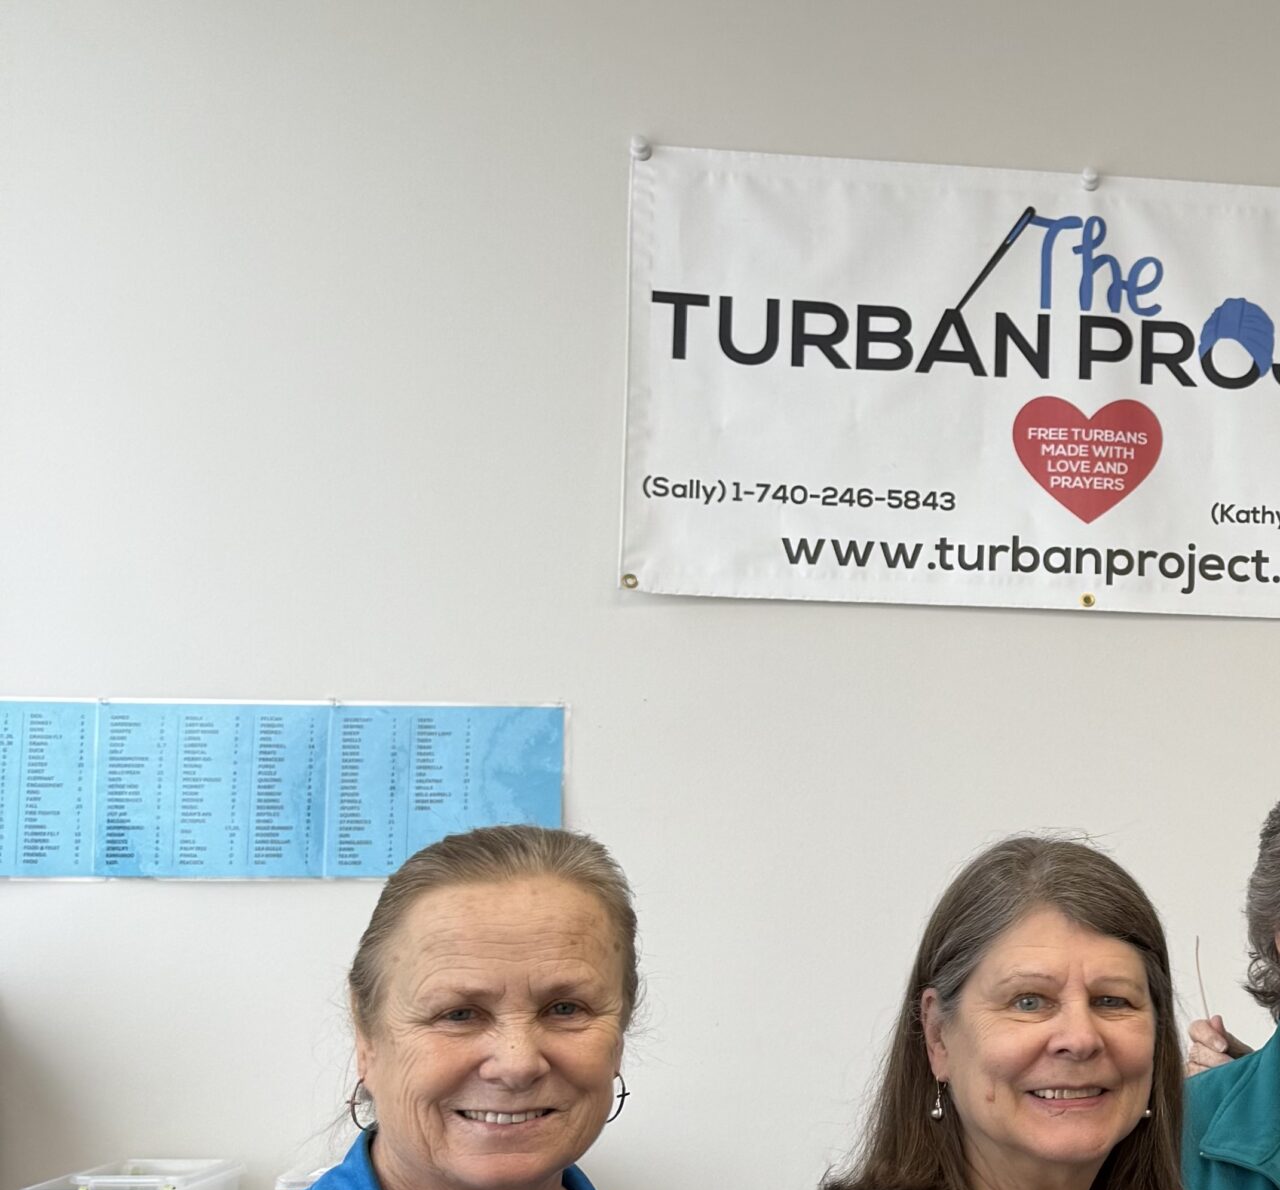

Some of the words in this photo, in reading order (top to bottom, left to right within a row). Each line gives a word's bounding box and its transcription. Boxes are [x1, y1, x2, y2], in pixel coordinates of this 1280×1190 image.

[1026, 214, 1164, 317] The
[651, 290, 1051, 380] TURBAN
[1028, 427, 1068, 441] FREE
[1071, 428, 1148, 445] TURBANS
[1041, 444, 1089, 457] MADE
[1092, 446, 1134, 459] WITH
[1047, 460, 1091, 473] LOVE
[1094, 462, 1129, 475] AND
[1050, 476, 1125, 491] PRAYERS
[642, 475, 726, 505] (Sally)
[731, 481, 956, 511] 1-740-246-5843
